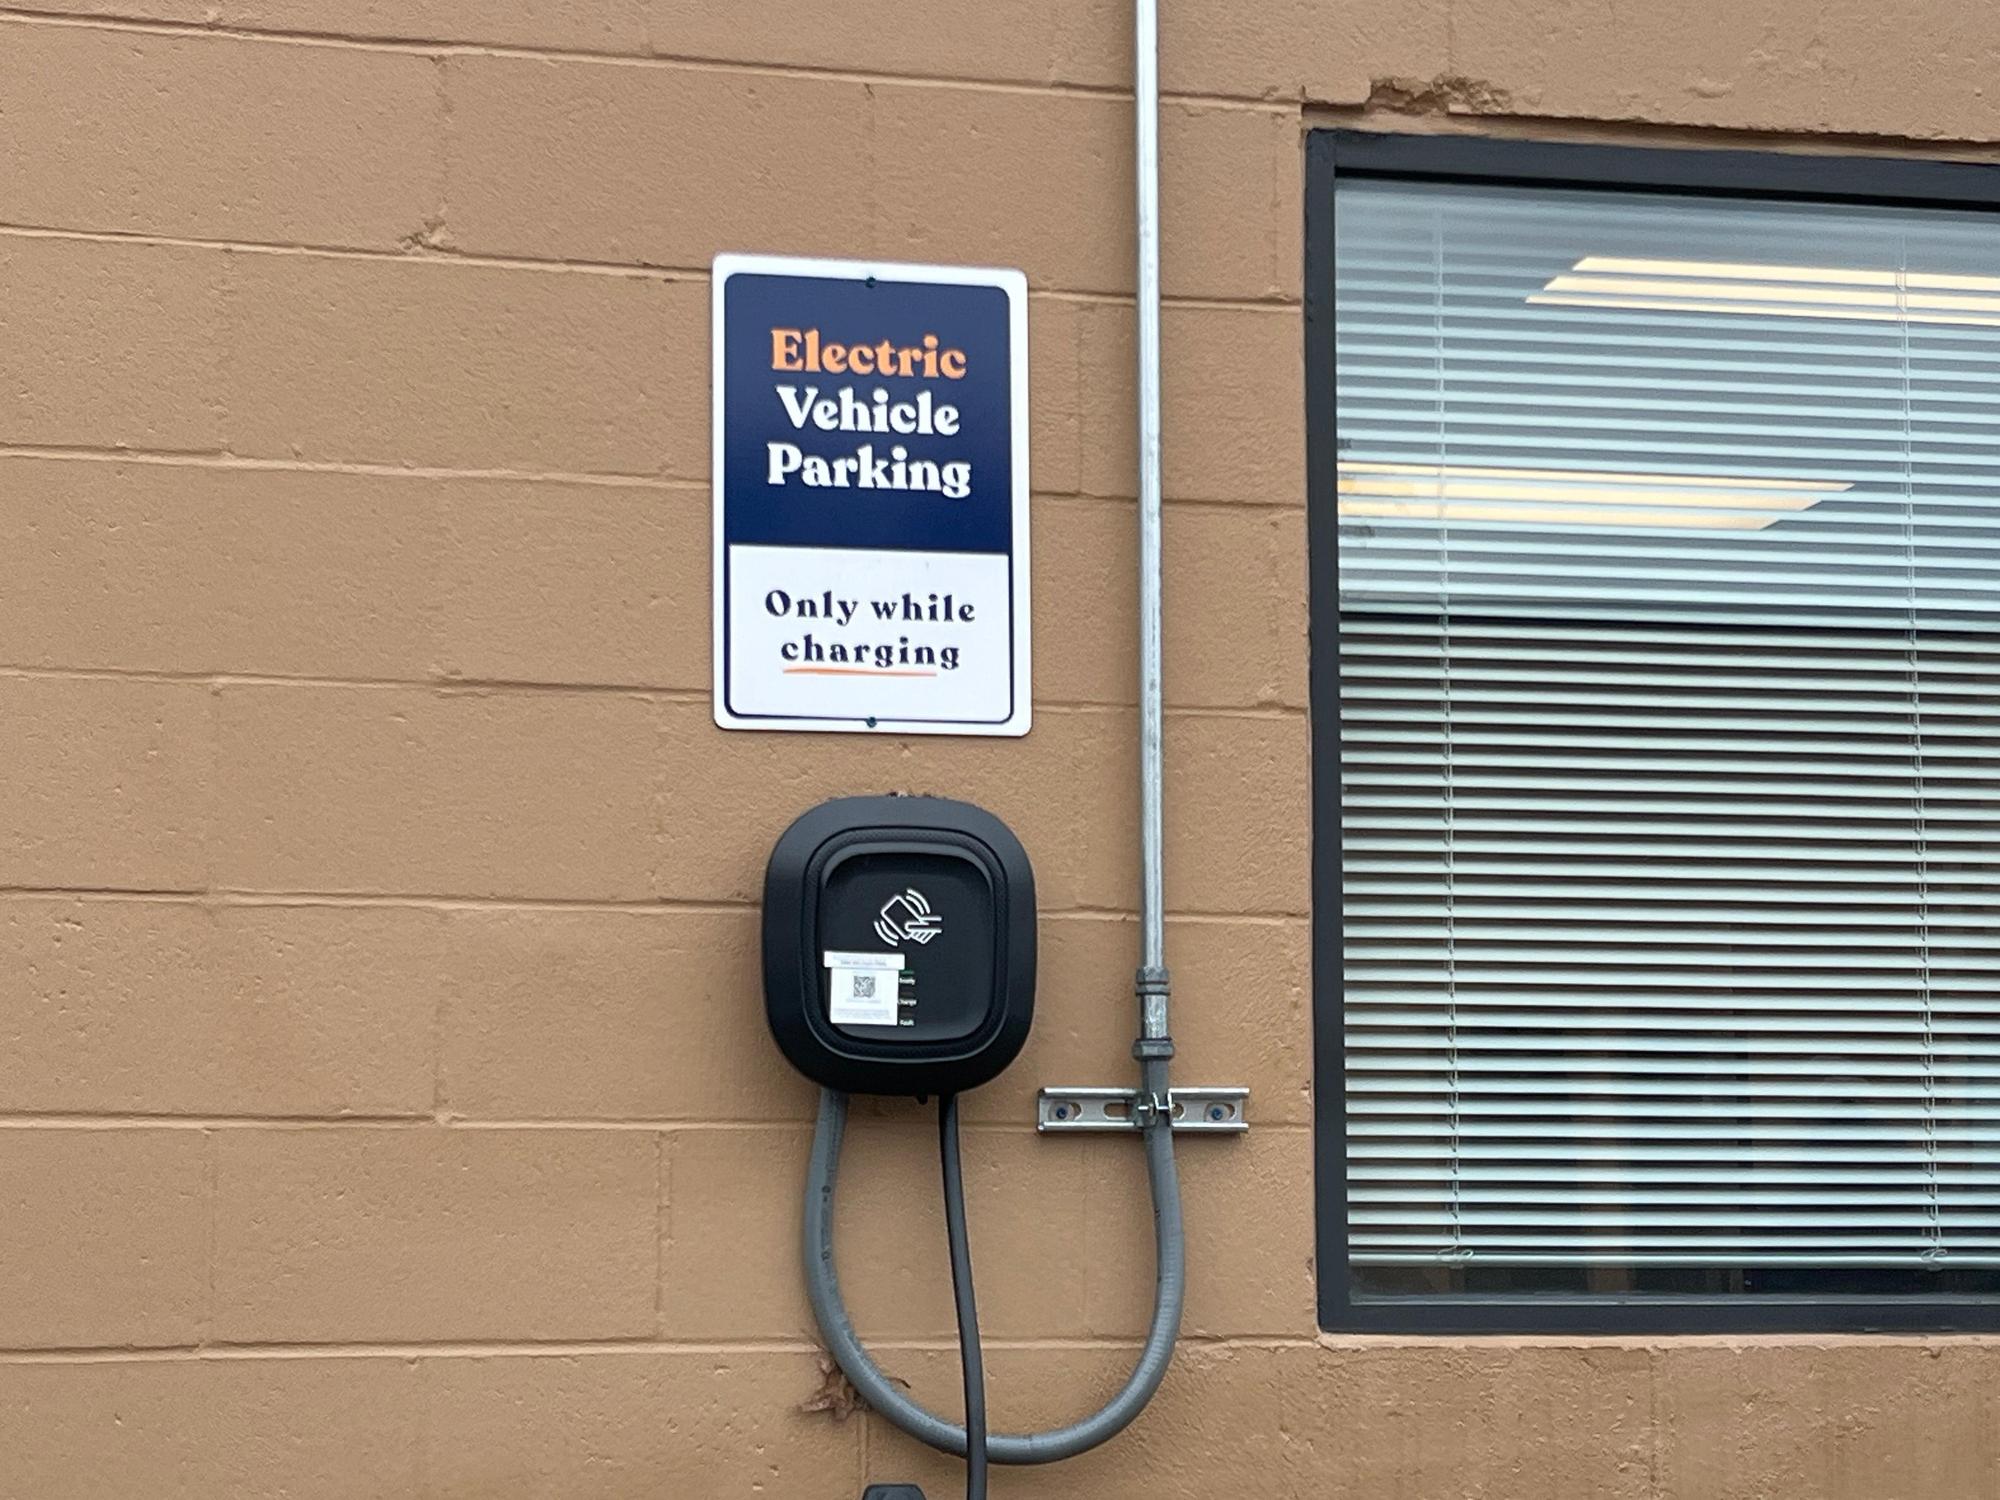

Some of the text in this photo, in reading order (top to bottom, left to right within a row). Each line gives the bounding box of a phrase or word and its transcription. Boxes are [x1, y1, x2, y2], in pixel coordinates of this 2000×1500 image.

[770, 328, 967, 379] Electric
[776, 385, 960, 436] Vehicle
[767, 442, 971, 498] Parking
[765, 589, 975, 626] Only while
[780, 633, 960, 670] charging
